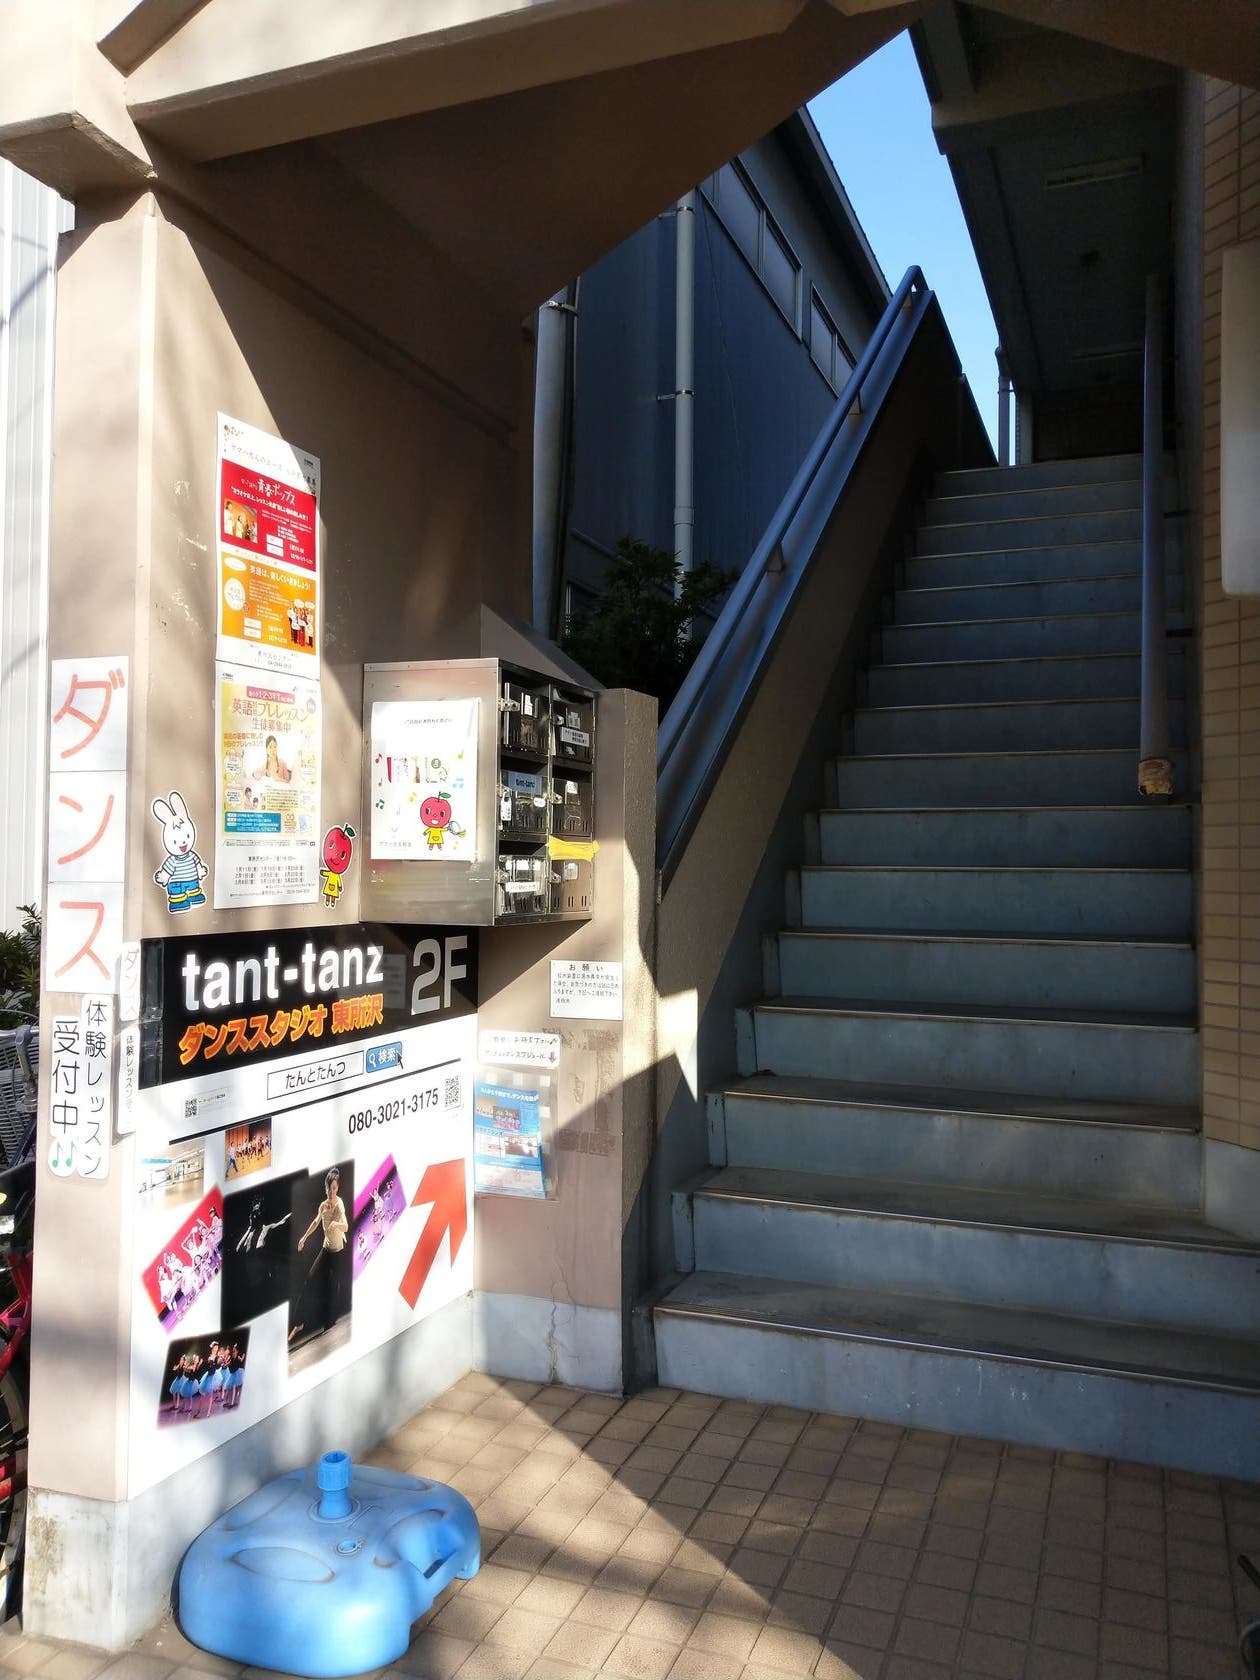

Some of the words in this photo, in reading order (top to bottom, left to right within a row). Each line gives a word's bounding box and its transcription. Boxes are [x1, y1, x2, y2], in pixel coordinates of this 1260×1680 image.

[252, 718, 292, 733] 生徒募集中
[53, 668, 126, 981] ダンス
[123, 947, 140, 1016] ダンス
[182, 943, 384, 1012] tant-tanz
[411, 935, 469, 1016] 2F
[569, 963, 604, 971] お願い
[178, 1003, 329, 1066] ダンススタジオ
[331, 992, 385, 1033] 東所沢
[52, 1020, 80, 1134] 受付中
[84, 999, 108, 1177] 体験レッスン
[284, 1060, 347, 1091] たんとたんつ
[378, 1047, 397, 1065] 検索
[348, 1087, 440, 1135] 080-3021-3175
